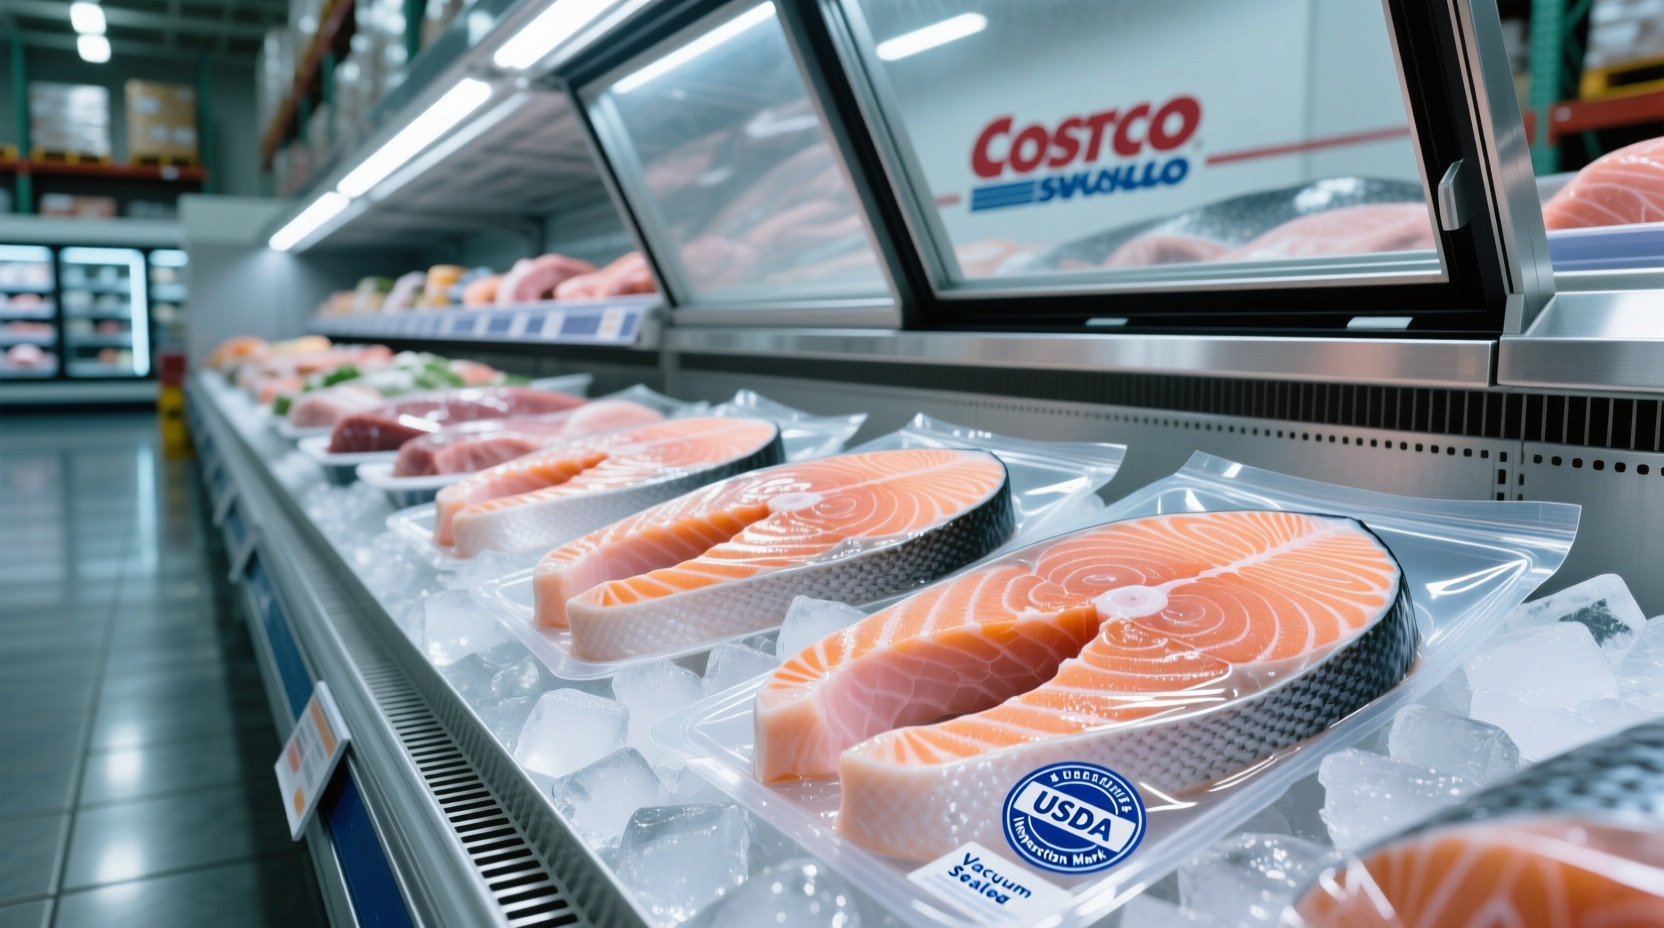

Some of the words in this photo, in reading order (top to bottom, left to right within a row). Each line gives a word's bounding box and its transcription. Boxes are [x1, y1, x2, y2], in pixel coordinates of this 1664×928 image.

[971, 95, 1202, 179] COSTCO
[1033, 790, 1113, 842] USDA
[963, 852, 1032, 899] Vacuum
